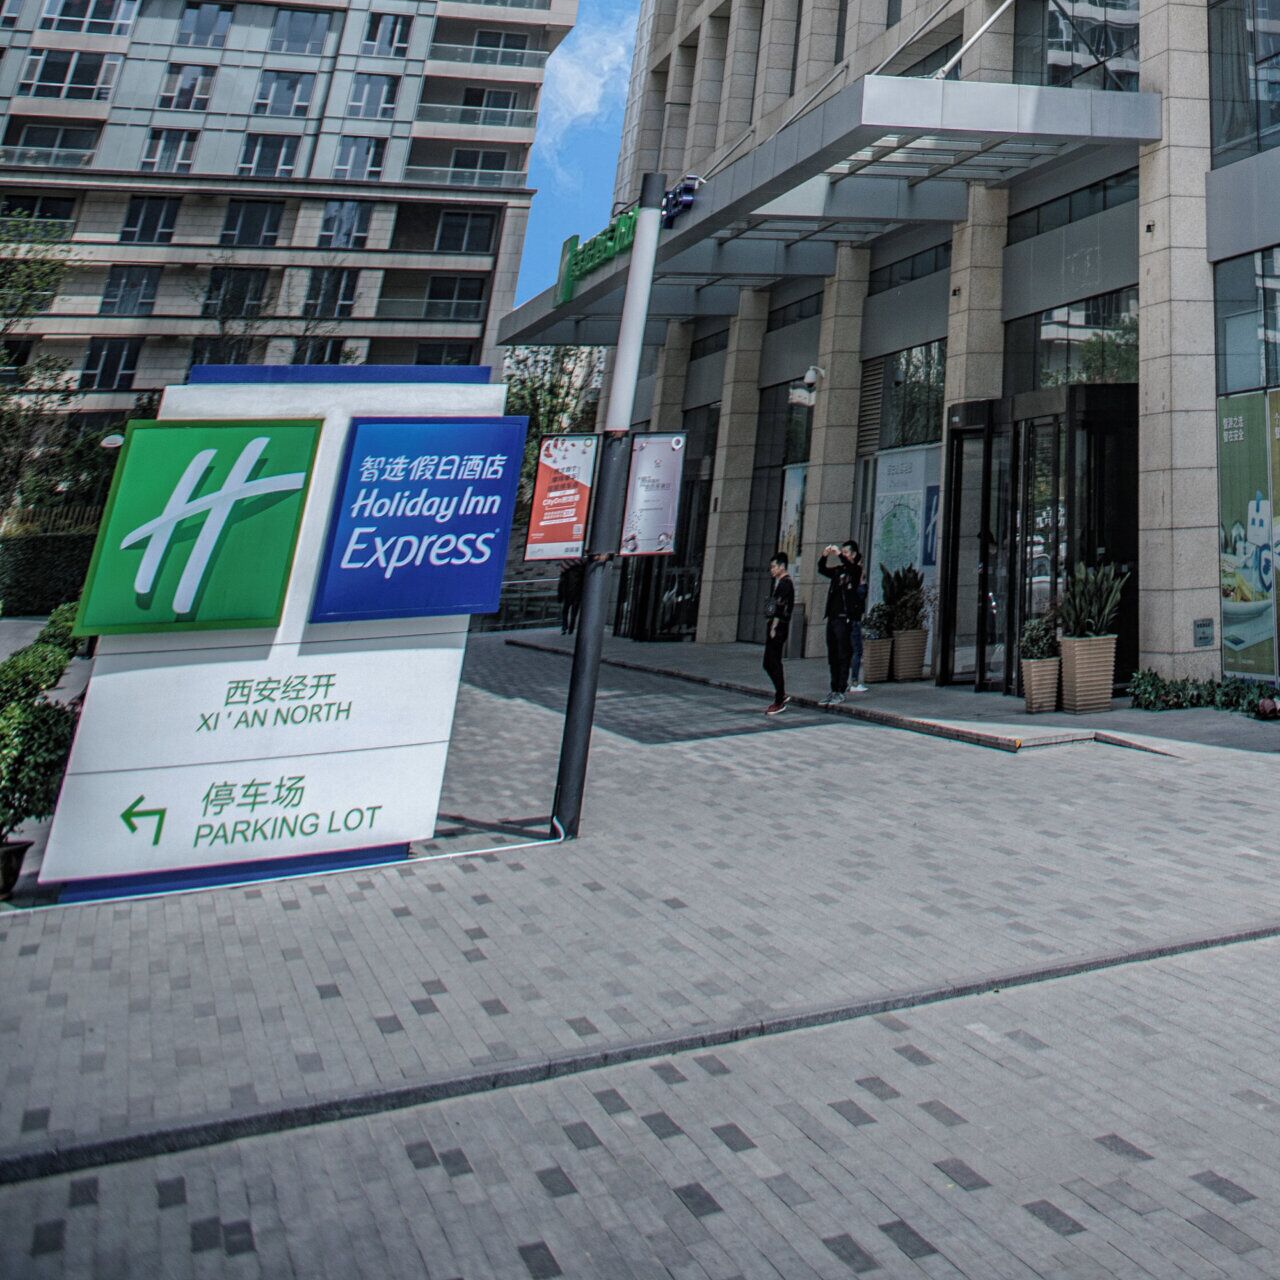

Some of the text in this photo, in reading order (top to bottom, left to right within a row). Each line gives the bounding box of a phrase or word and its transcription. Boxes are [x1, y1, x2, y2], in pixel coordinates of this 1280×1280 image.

[360, 454, 508, 482] 智选假日酒店
[351, 486, 501, 524] Holiday Inn
[340, 527, 497, 579] Express
[224, 673, 336, 707] 西安经开
[274, 701, 352, 727] NORTH
[202, 776, 305, 817] 停车场
[193, 806, 382, 848] PARKING LOT
